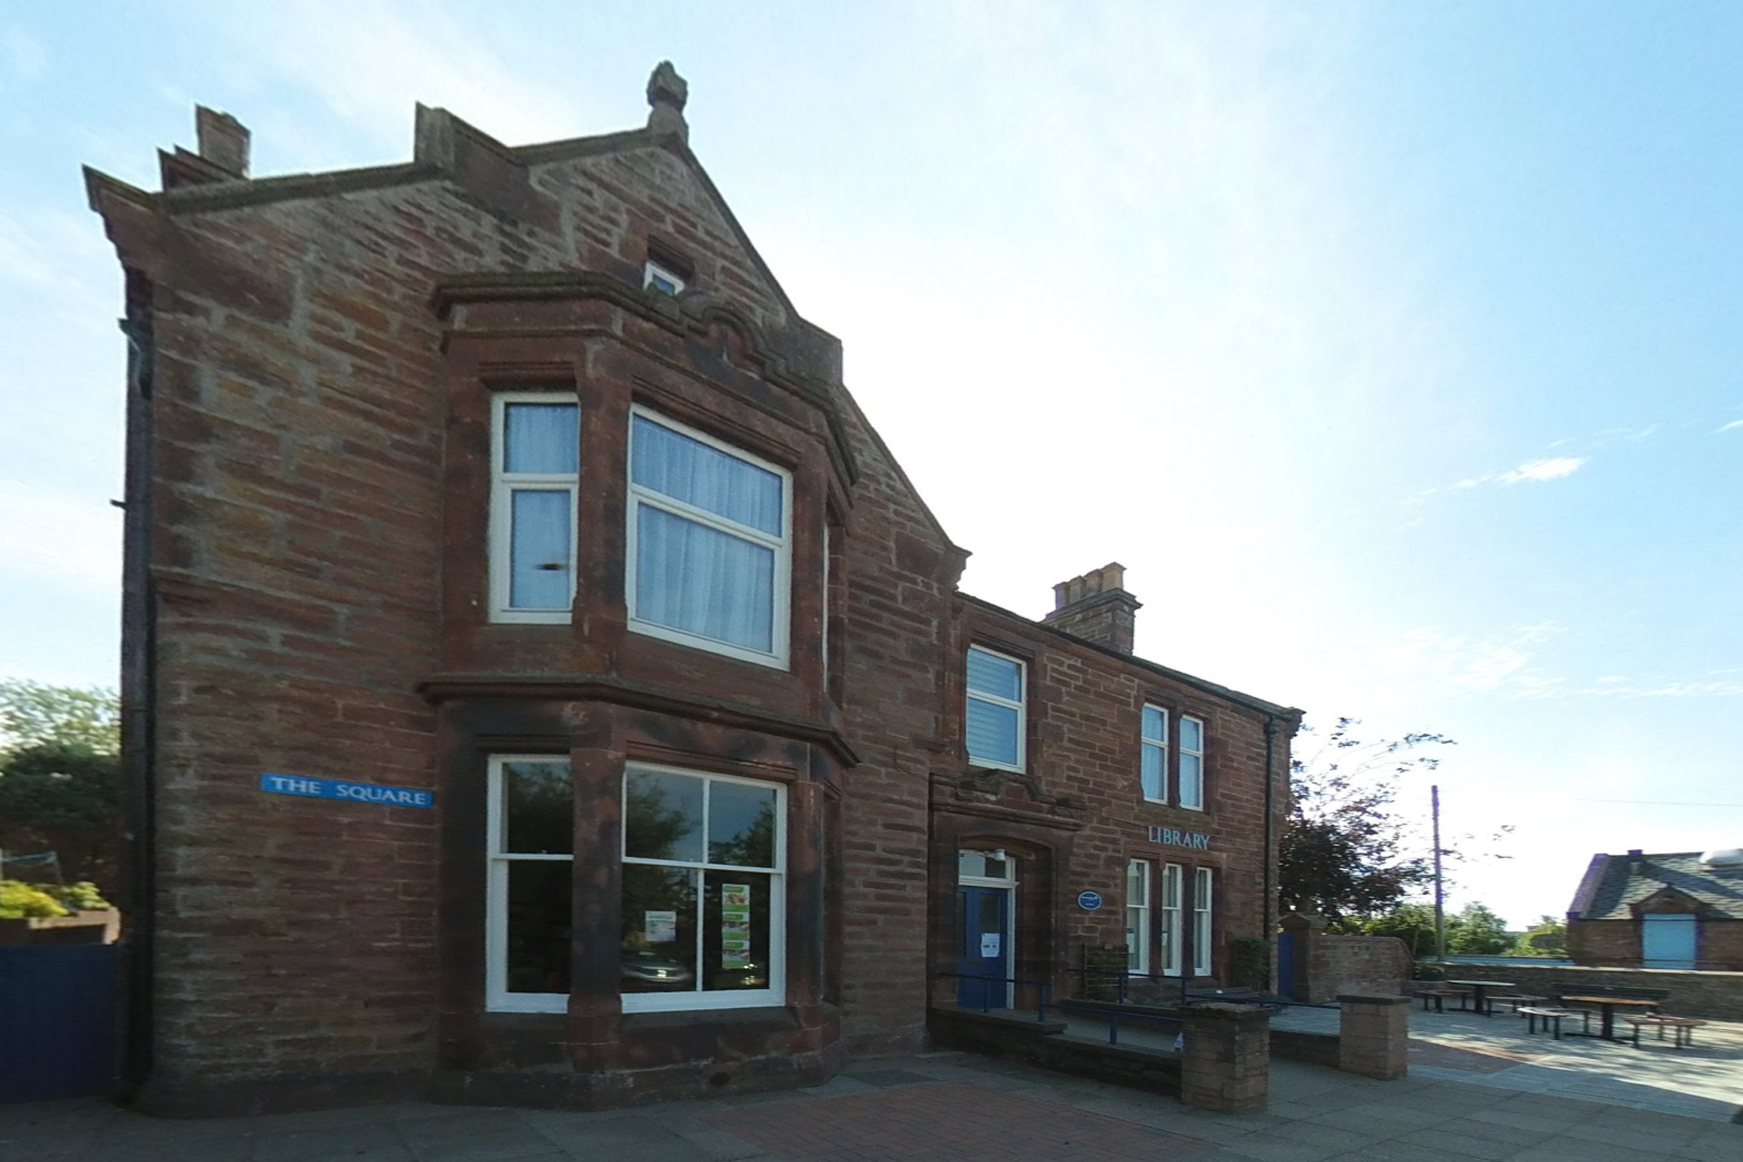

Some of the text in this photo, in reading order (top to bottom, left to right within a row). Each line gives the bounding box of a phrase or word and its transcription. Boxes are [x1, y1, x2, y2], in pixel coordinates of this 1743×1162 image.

[270, 777, 426, 805] THE SQUARE
[1148, 825, 1210, 850] LIBRARY
